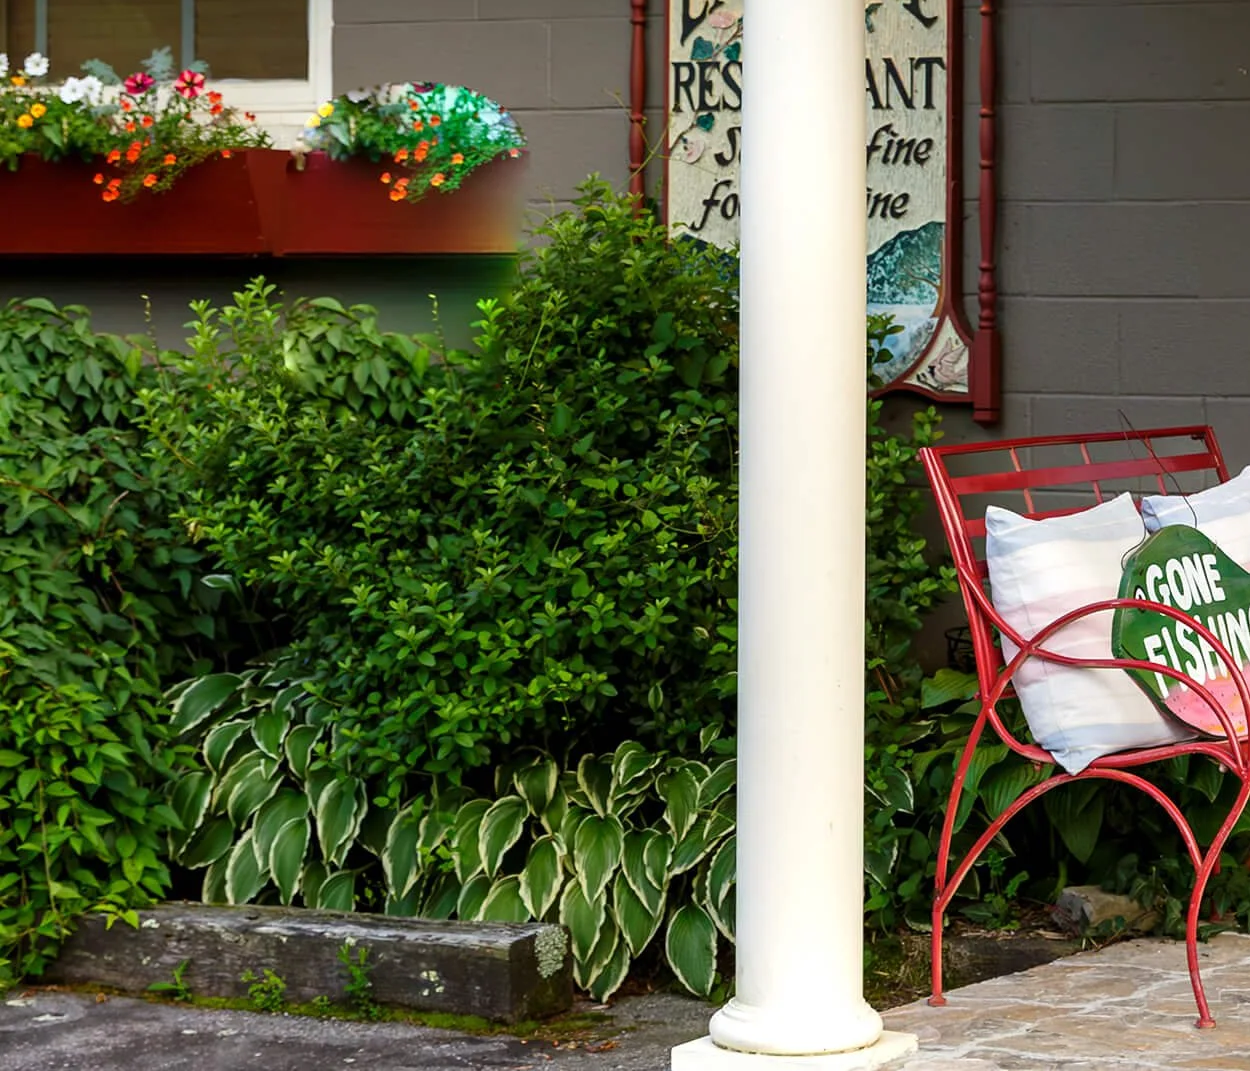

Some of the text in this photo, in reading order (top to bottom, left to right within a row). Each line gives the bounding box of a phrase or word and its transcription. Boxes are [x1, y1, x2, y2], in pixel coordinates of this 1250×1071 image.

[671, 57, 946, 110] RESANT
[866, 123, 934, 168] fine
[1145, 552, 1226, 616] GONE
